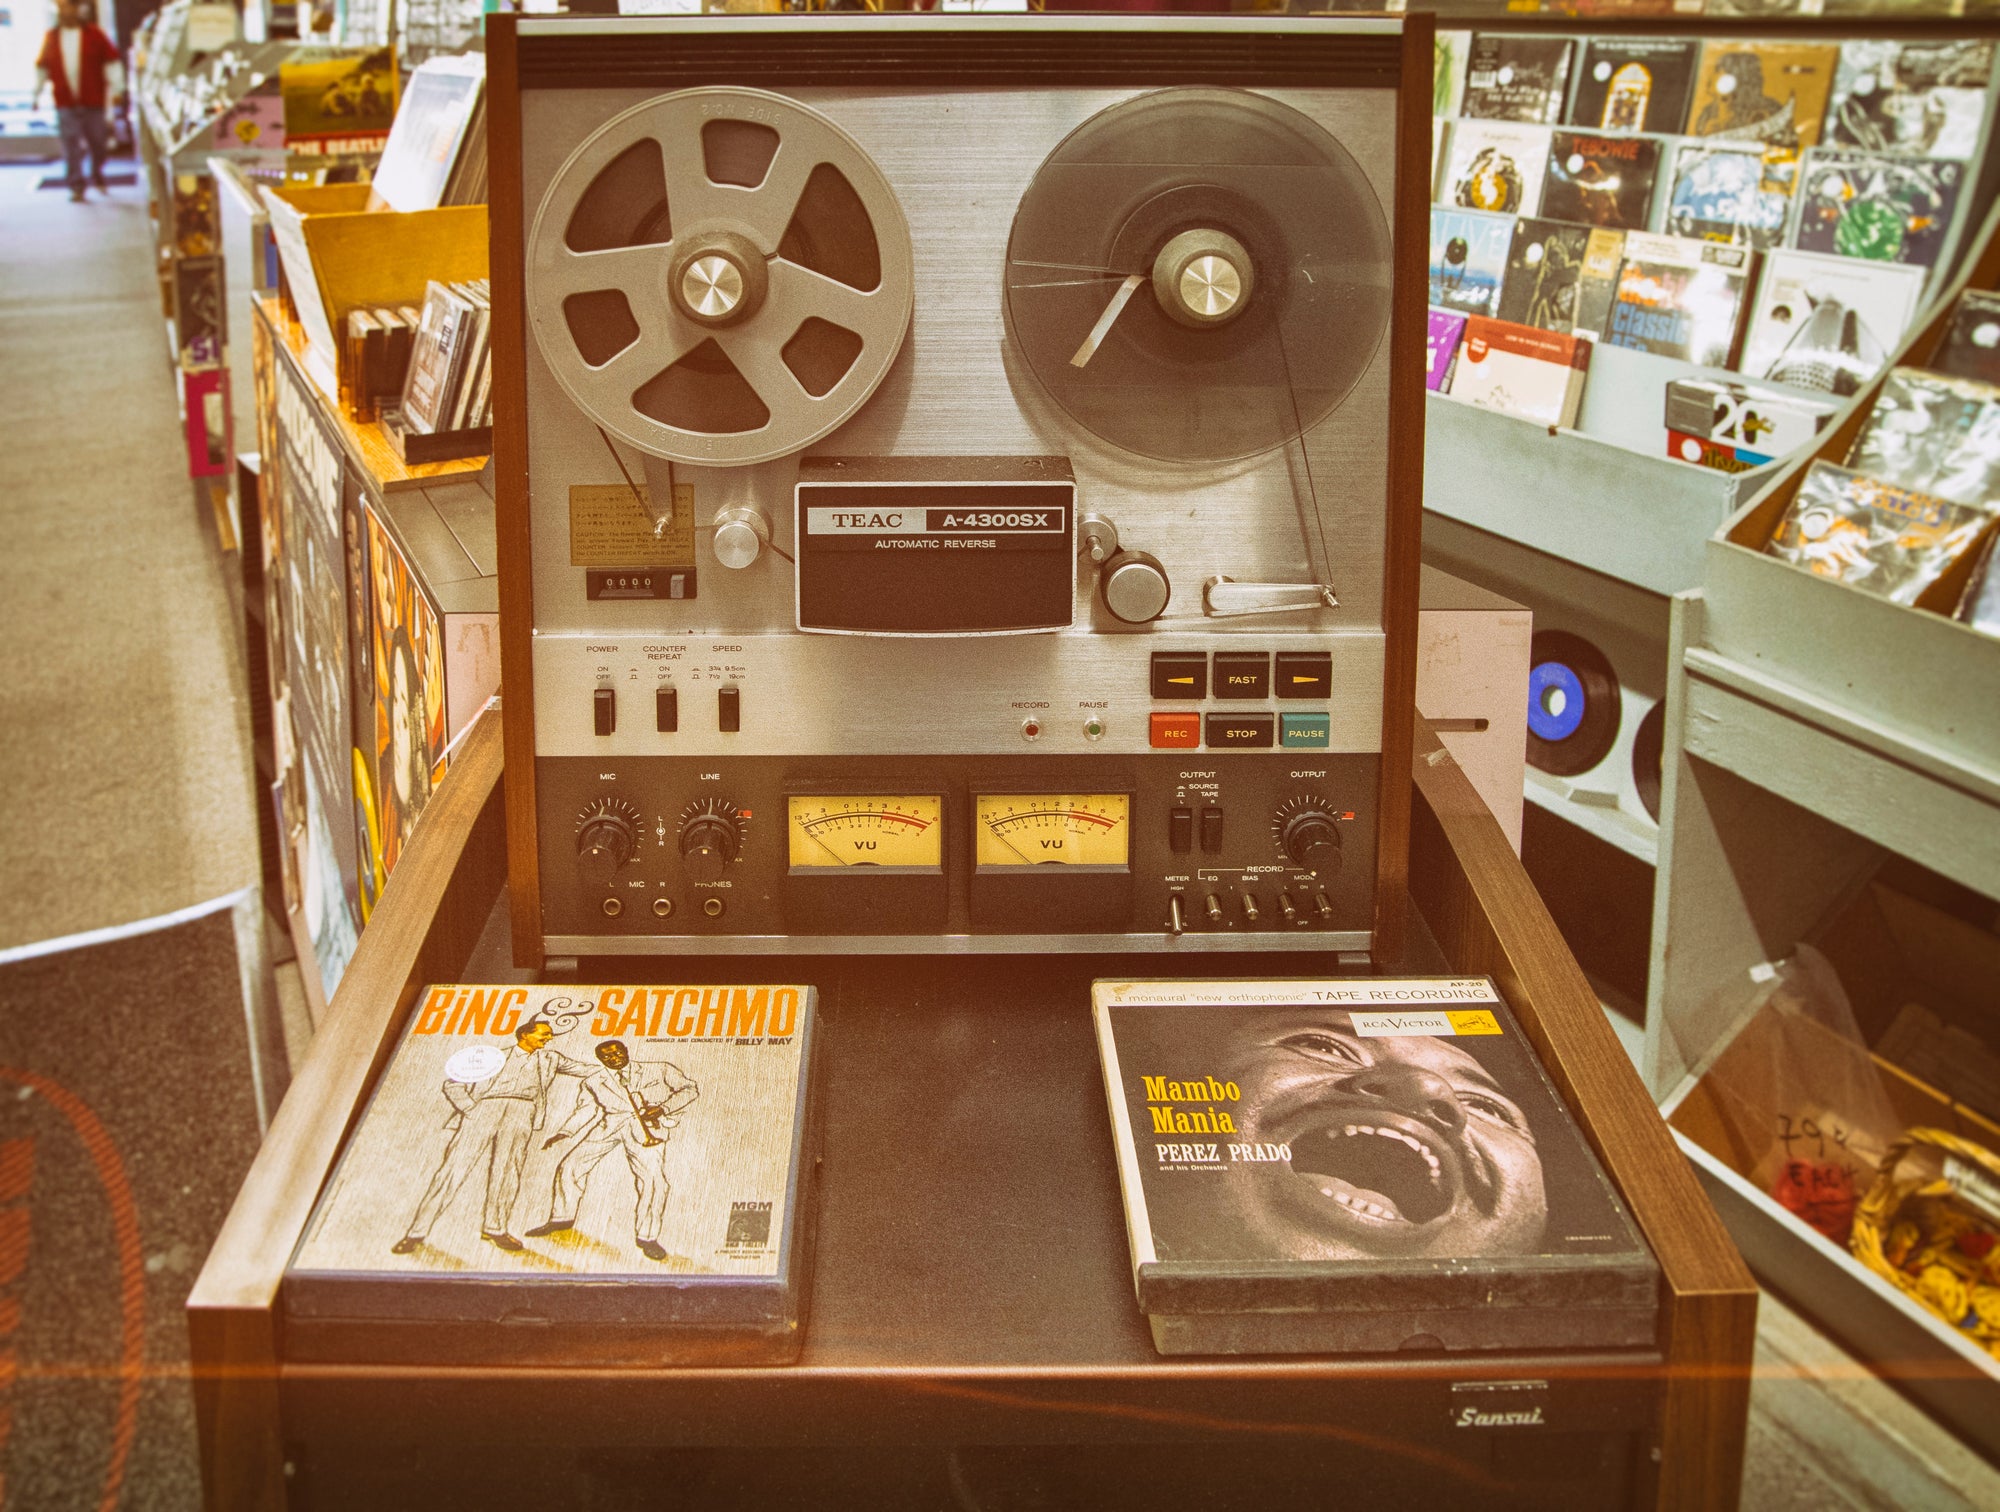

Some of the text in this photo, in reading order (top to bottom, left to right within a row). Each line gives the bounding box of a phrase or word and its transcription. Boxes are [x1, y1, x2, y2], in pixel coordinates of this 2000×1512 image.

[832, 512, 1048, 529] TEAC A-4300SX
[874, 539, 997, 549] AUTOMATIC REVERSE
[586, 645, 619, 653] POWER
[642, 645, 687, 653] COUNTER
[712, 644, 743, 652] SPEED
[647, 653, 682, 661] REPEAT
[1228, 676, 1258, 685] FAST
[1011, 701, 1051, 709] RECORD
[1079, 701, 1109, 709] PAUSE
[1164, 730, 1188, 739] REC
[1226, 729, 1258, 739] STOP
[1288, 729, 1326, 739] PAUSE
[1179, 771, 1217, 779] OUTPUT
[1290, 770, 1327, 778] OUTPUT
[854, 840, 877, 850] VU
[1040, 839, 1064, 849] VU
[1246, 865, 1284, 873] RECORD
[1114, 994, 1123, 1003] a
[1128, 993, 1187, 1003] monaural
[1312, 990, 1363, 1002] TAPE
[1369, 988, 1490, 1001] RECORDING
[589, 988, 800, 1037] SATCHMO
[735, 1037, 764, 1046] BILLY
[768, 1037, 793, 1046] MAY
[1140, 1075, 1241, 1102] Mambo
[1147, 1106, 1238, 1134] Mania
[1155, 1143, 1292, 1162] PEREZ PRADO
[731, 1201, 773, 1210] MGM
[1455, 1406, 1545, 1427] Sansui
